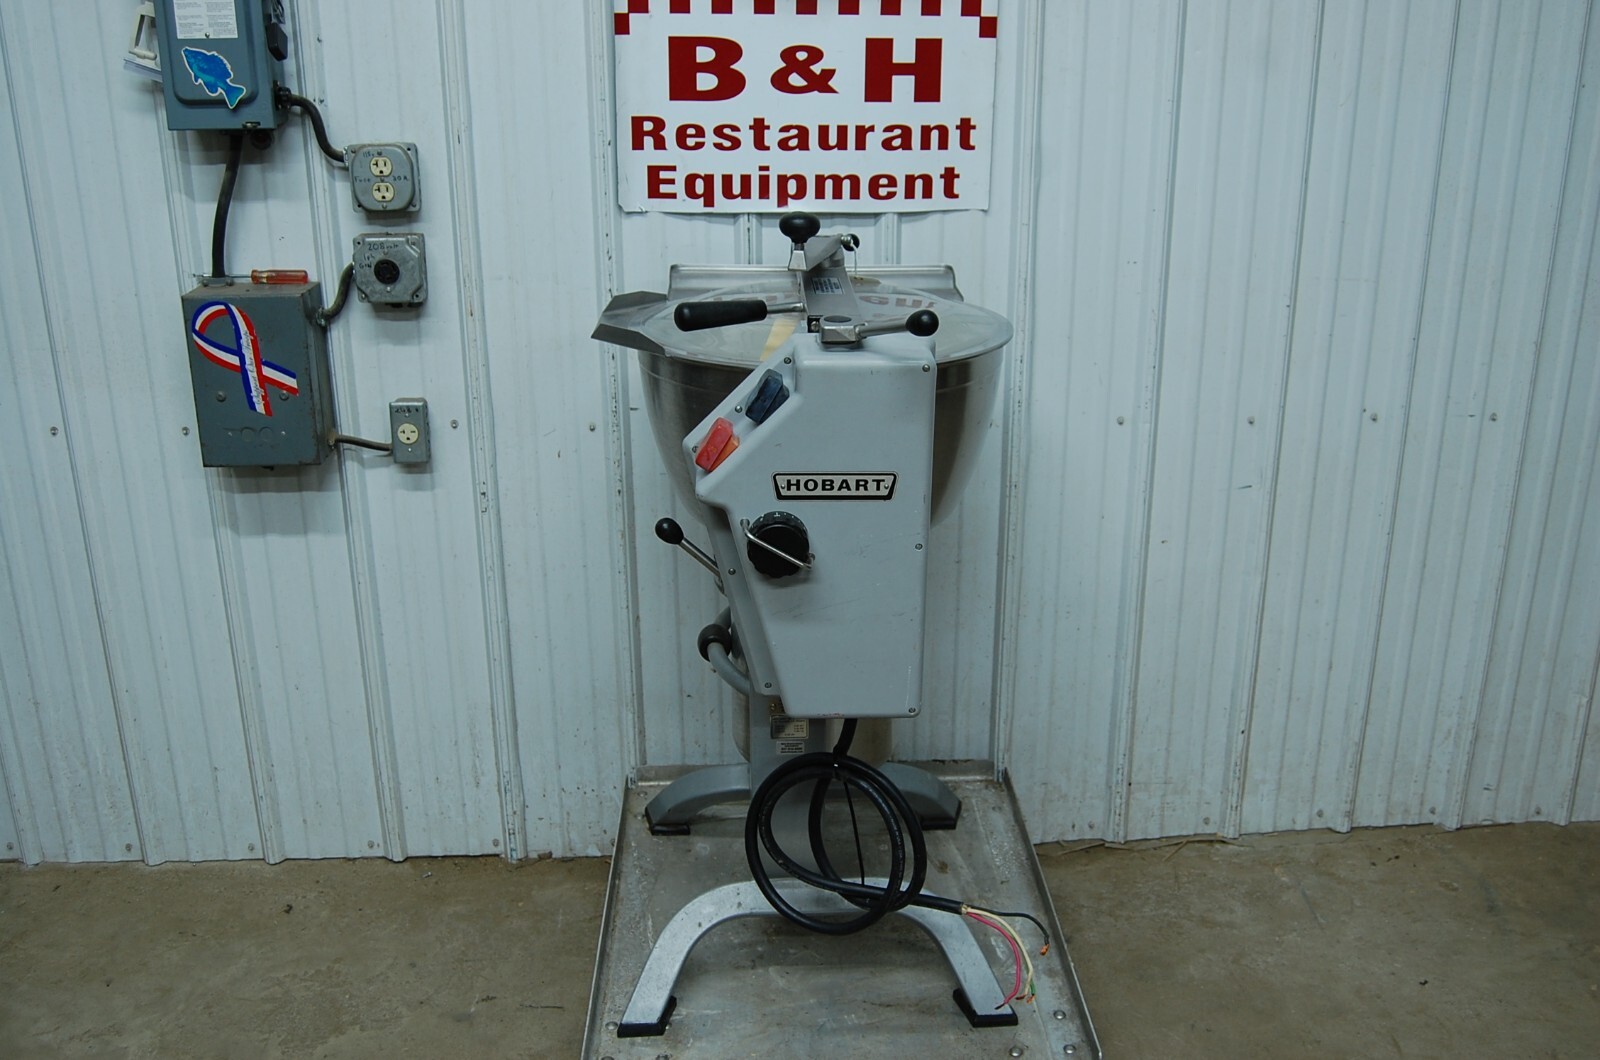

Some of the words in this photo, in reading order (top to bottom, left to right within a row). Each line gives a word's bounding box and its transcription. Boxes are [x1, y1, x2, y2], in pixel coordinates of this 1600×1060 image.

[668, 36, 747, 101] B
[770, 44, 839, 95] &
[864, 37, 943, 103] H
[630, 115, 977, 152] Restaurant
[647, 165, 961, 208] Equipment
[367, 242, 385, 251] 208
[786, 478, 885, 492] HOBART
